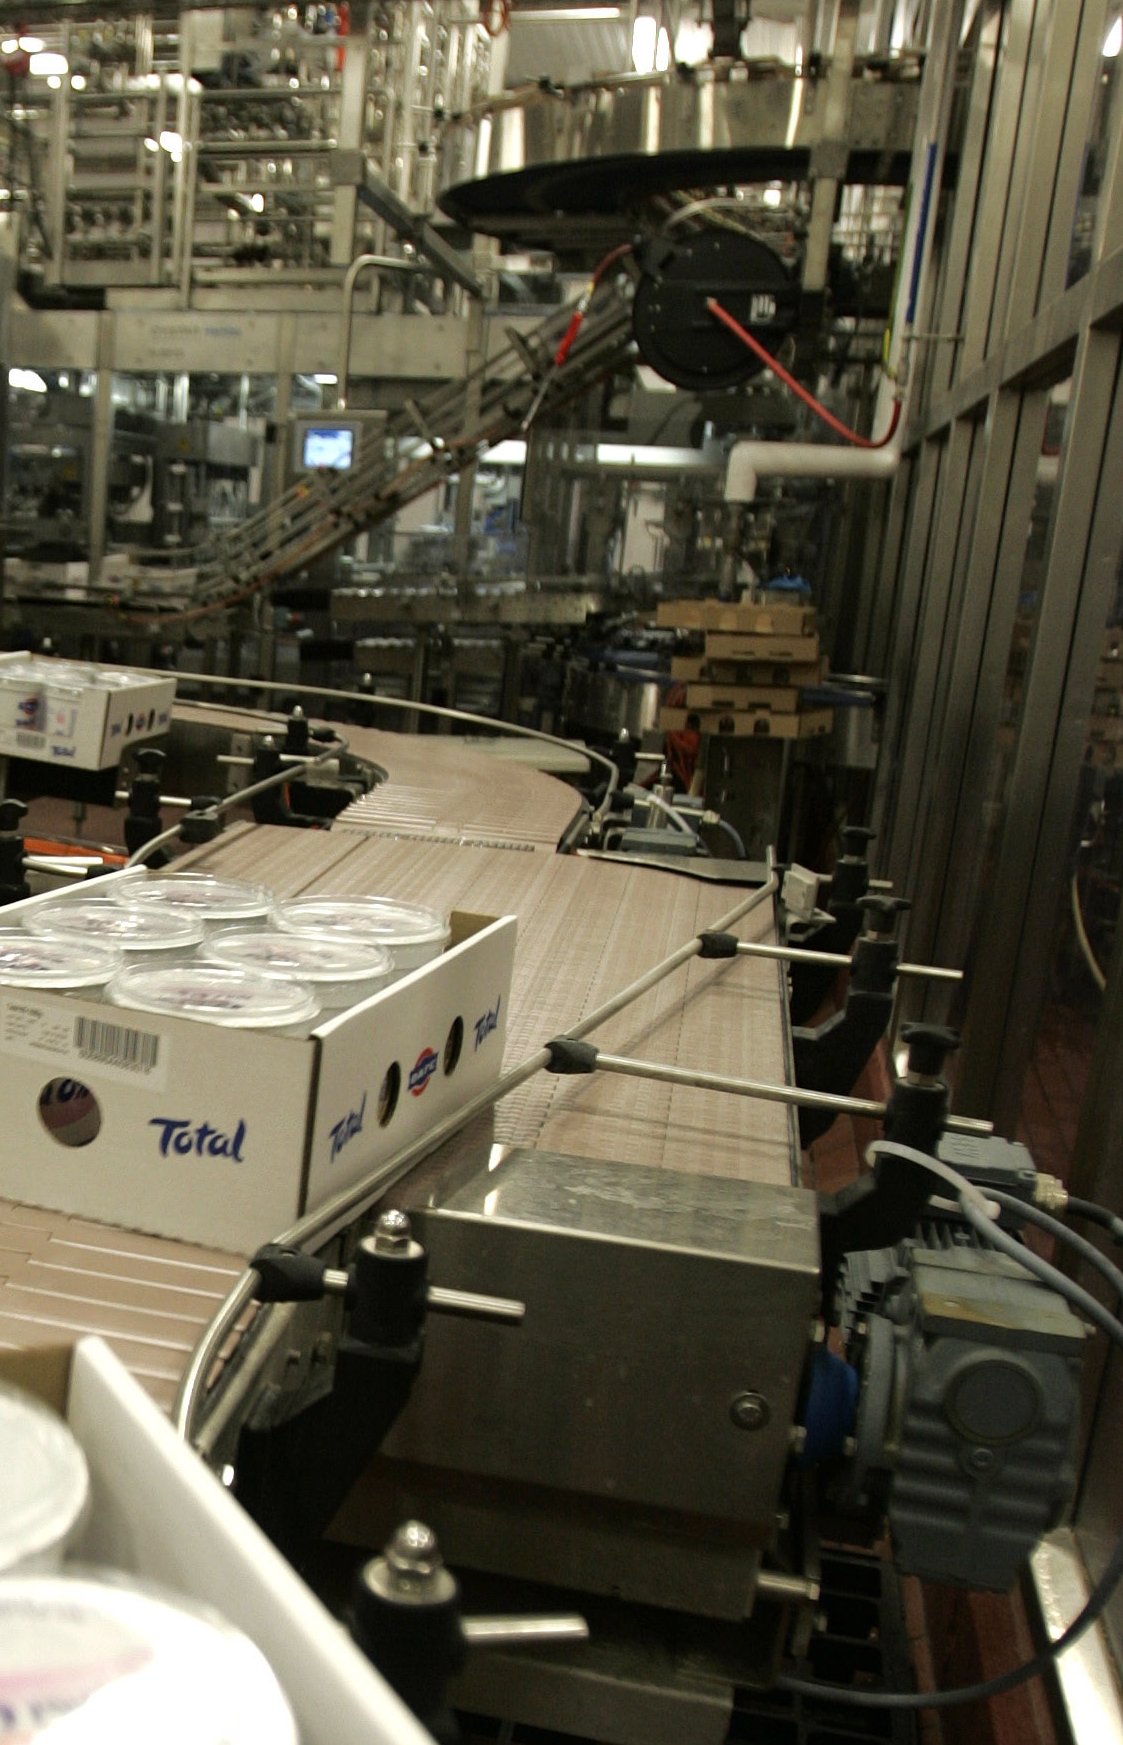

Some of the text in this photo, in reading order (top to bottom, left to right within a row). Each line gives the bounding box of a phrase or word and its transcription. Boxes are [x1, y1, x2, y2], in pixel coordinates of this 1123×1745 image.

[474, 994, 502, 1052] Total
[148, 1117, 247, 1163] Total
[328, 1091, 367, 1164] Total
